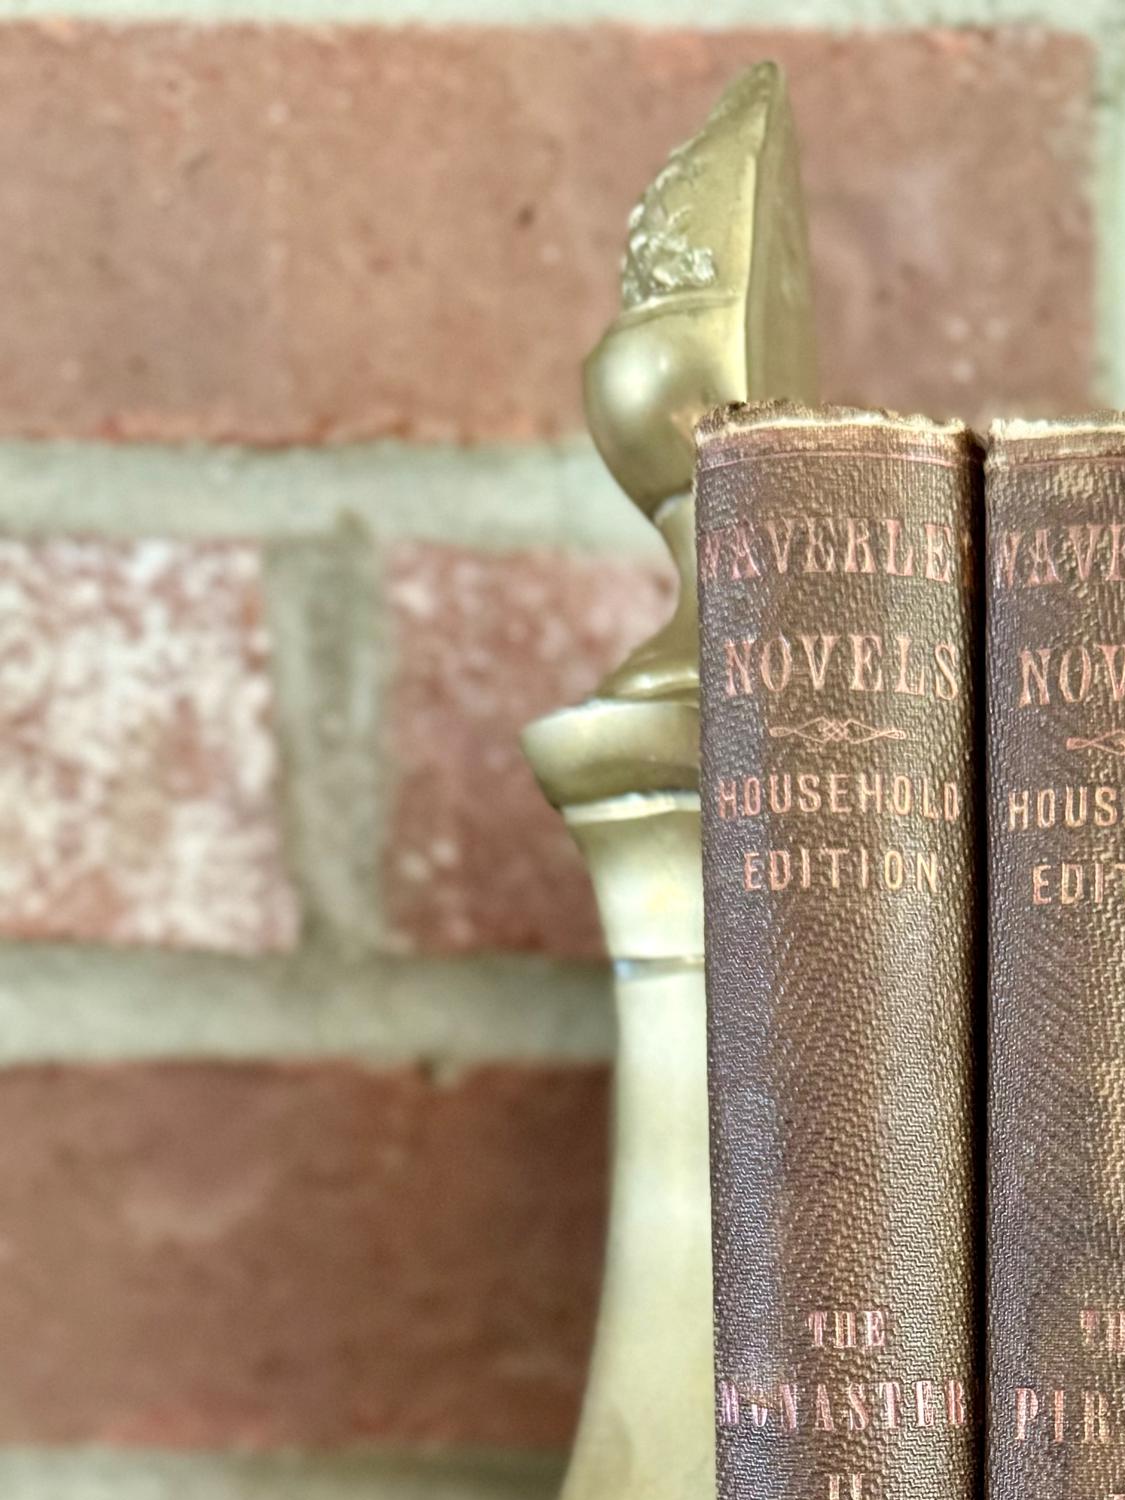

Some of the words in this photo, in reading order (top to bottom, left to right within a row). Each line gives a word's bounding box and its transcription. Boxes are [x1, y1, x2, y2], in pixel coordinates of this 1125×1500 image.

[700, 515, 972, 588] WAVERLE
[724, 634, 959, 700] NOVELS
[716, 773, 959, 821] HOUSEHOLD
[743, 848, 938, 892] EDITION
[807, 1310, 886, 1349] THE
